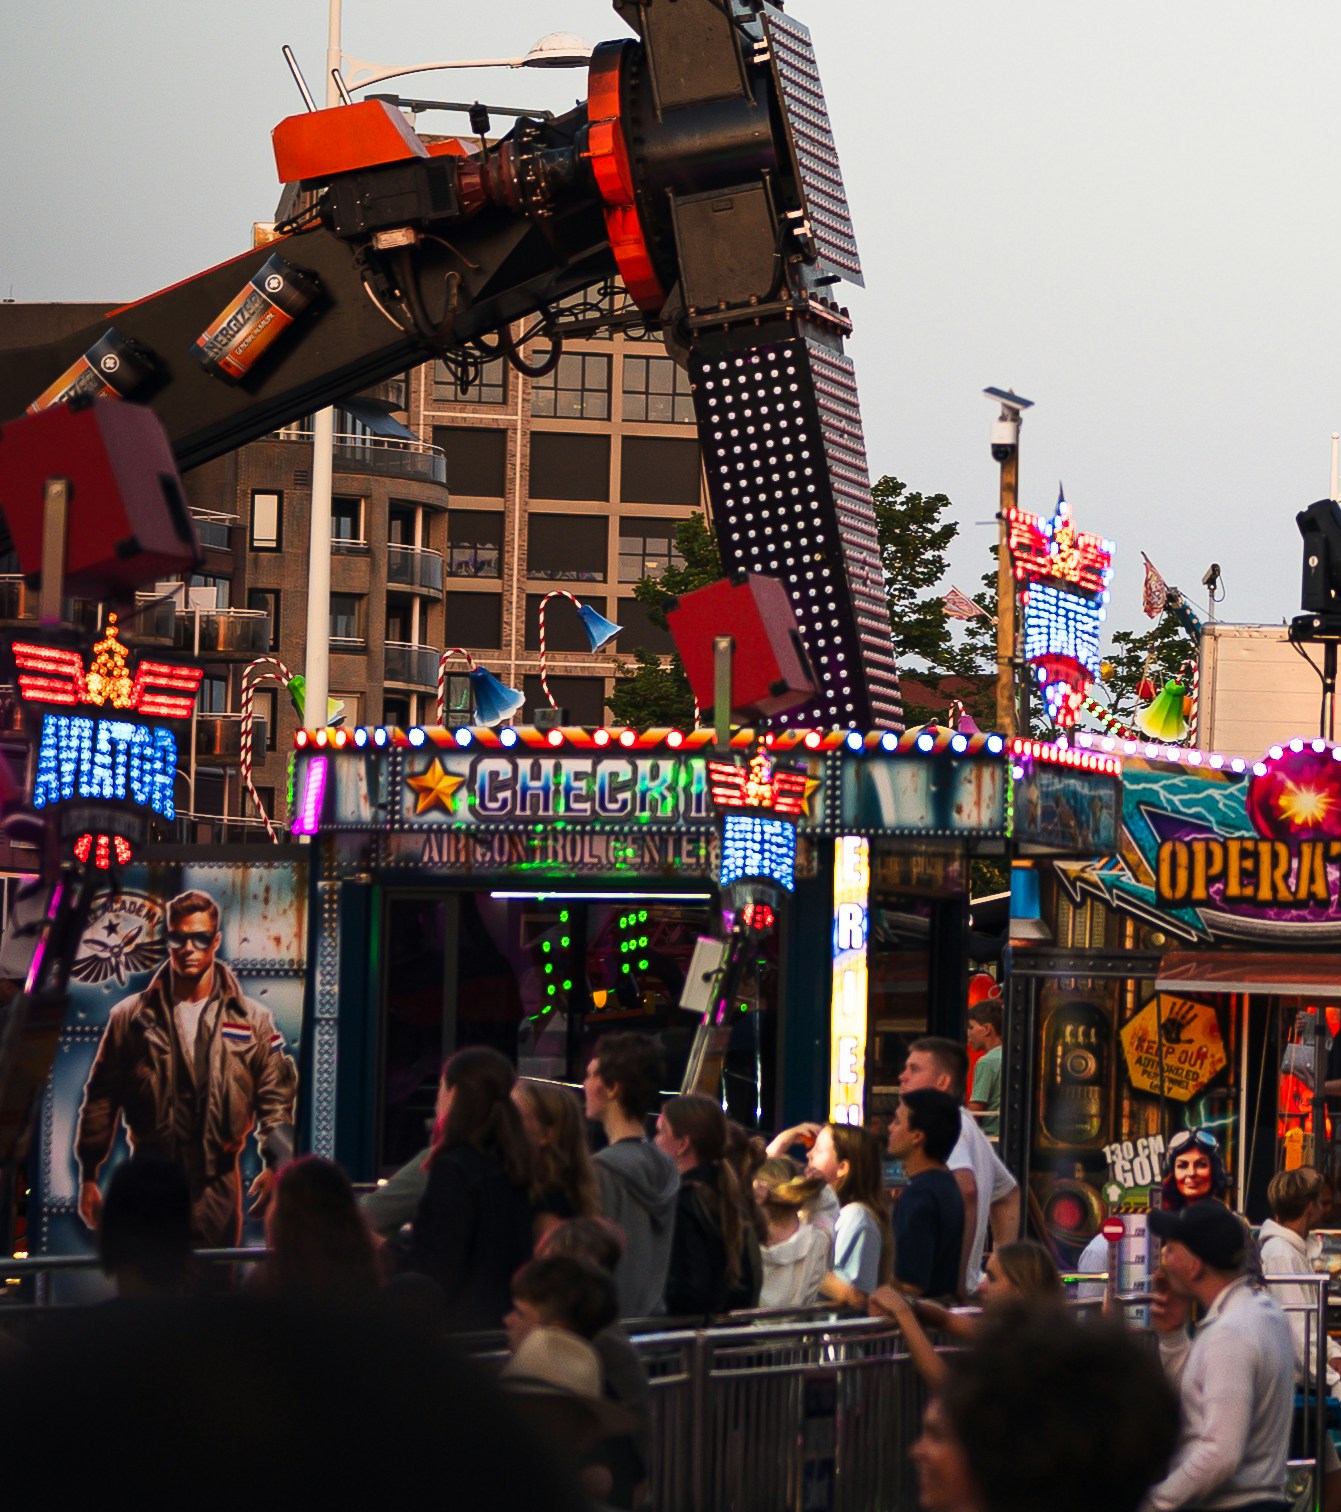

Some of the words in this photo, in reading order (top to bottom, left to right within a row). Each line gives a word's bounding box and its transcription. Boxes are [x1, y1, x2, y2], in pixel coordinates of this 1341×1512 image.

[34, 713, 178, 821] AVIATOR
[474, 758, 673, 818] CHECK
[421, 834, 466, 864] AIR
[474, 834, 600, 864] CONTROL
[1102, 1141, 1134, 1164] 130
[1114, 1154, 1162, 1188] GO!
